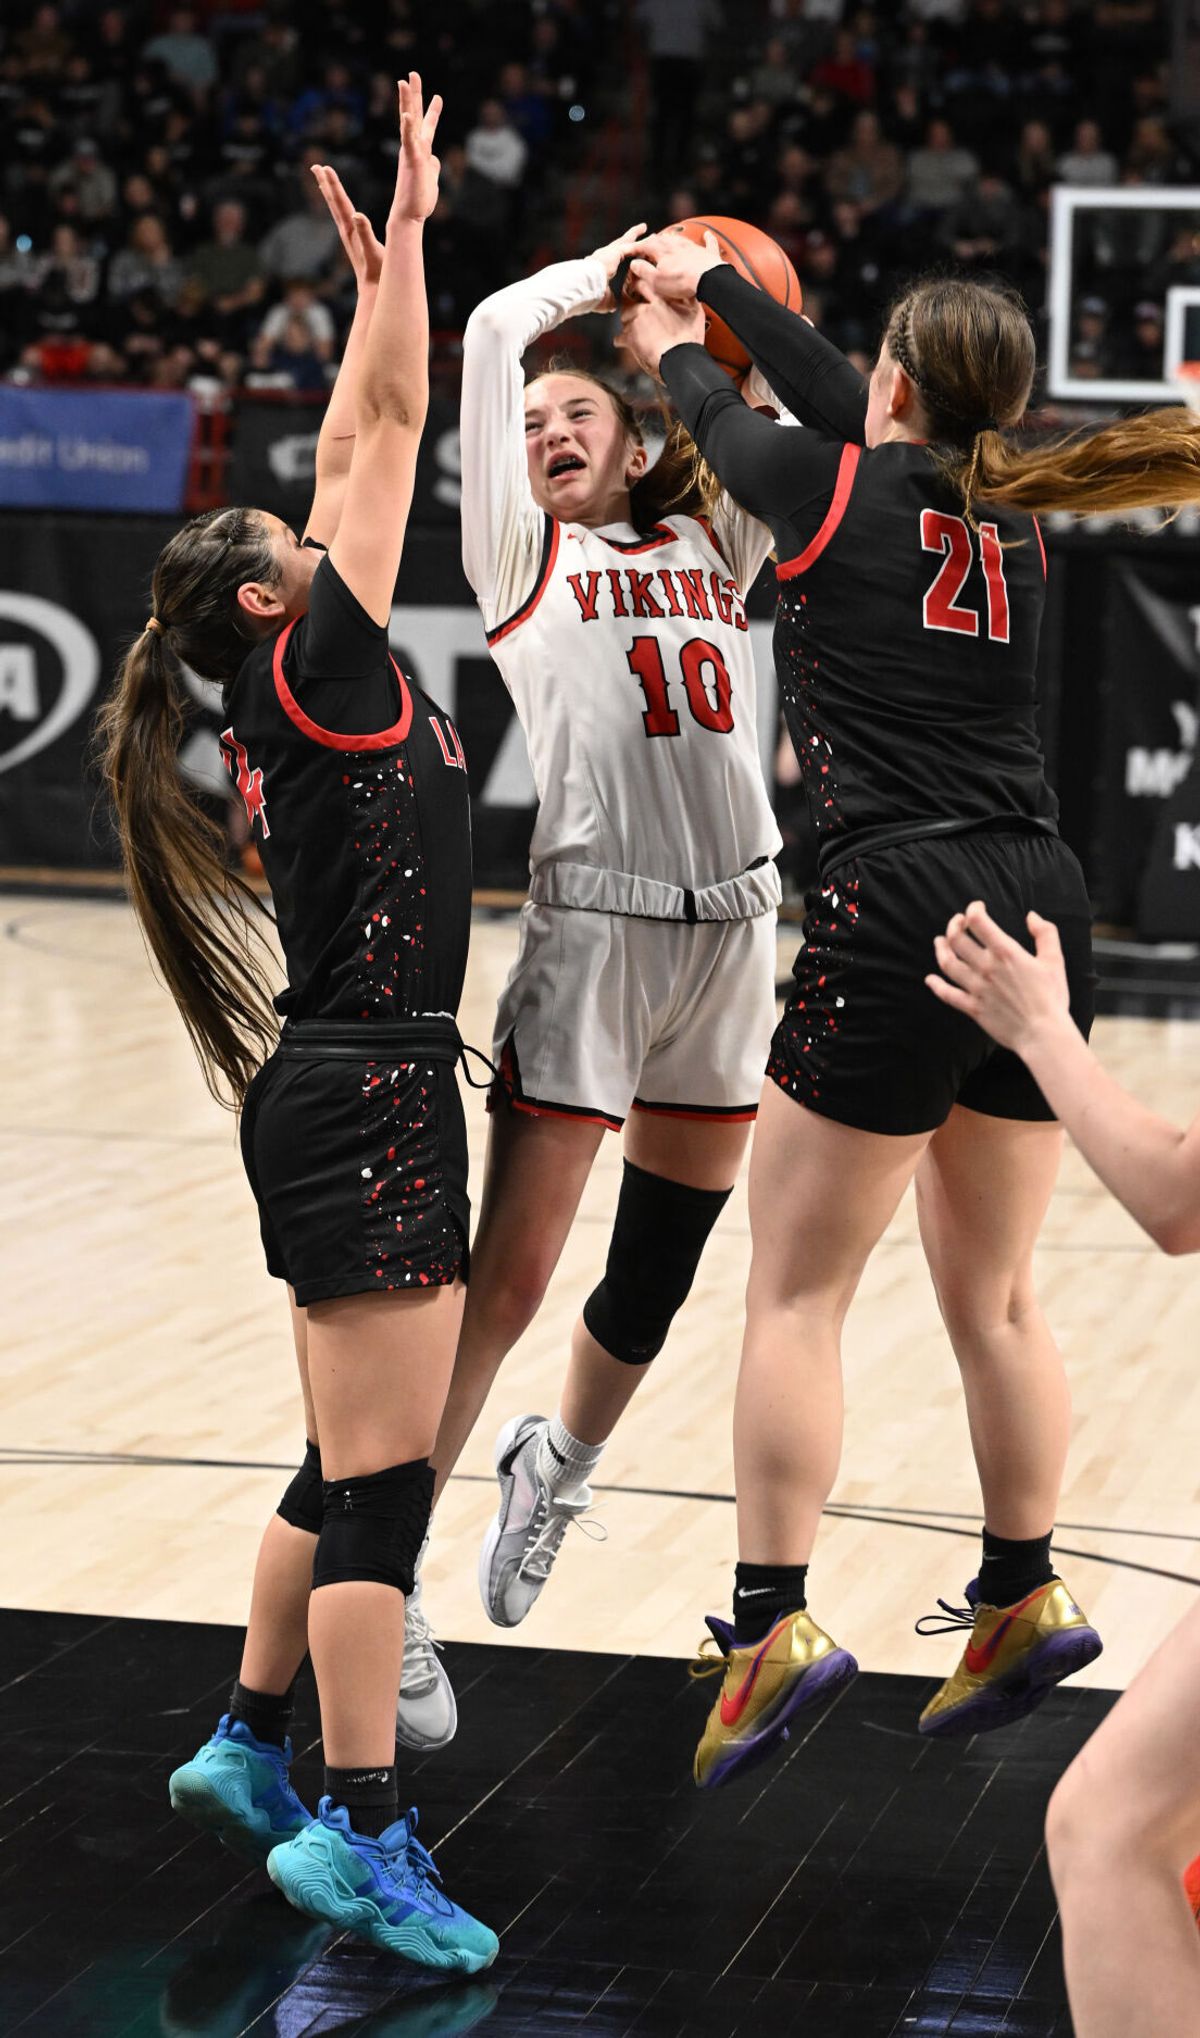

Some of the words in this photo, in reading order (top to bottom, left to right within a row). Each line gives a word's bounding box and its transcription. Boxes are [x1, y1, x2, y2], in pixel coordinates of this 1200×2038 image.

[57, 434, 150, 475] Union
[566, 568, 749, 632] VIKINGS
[920, 508, 1010, 644] 21
[625, 635, 735, 738] 10
